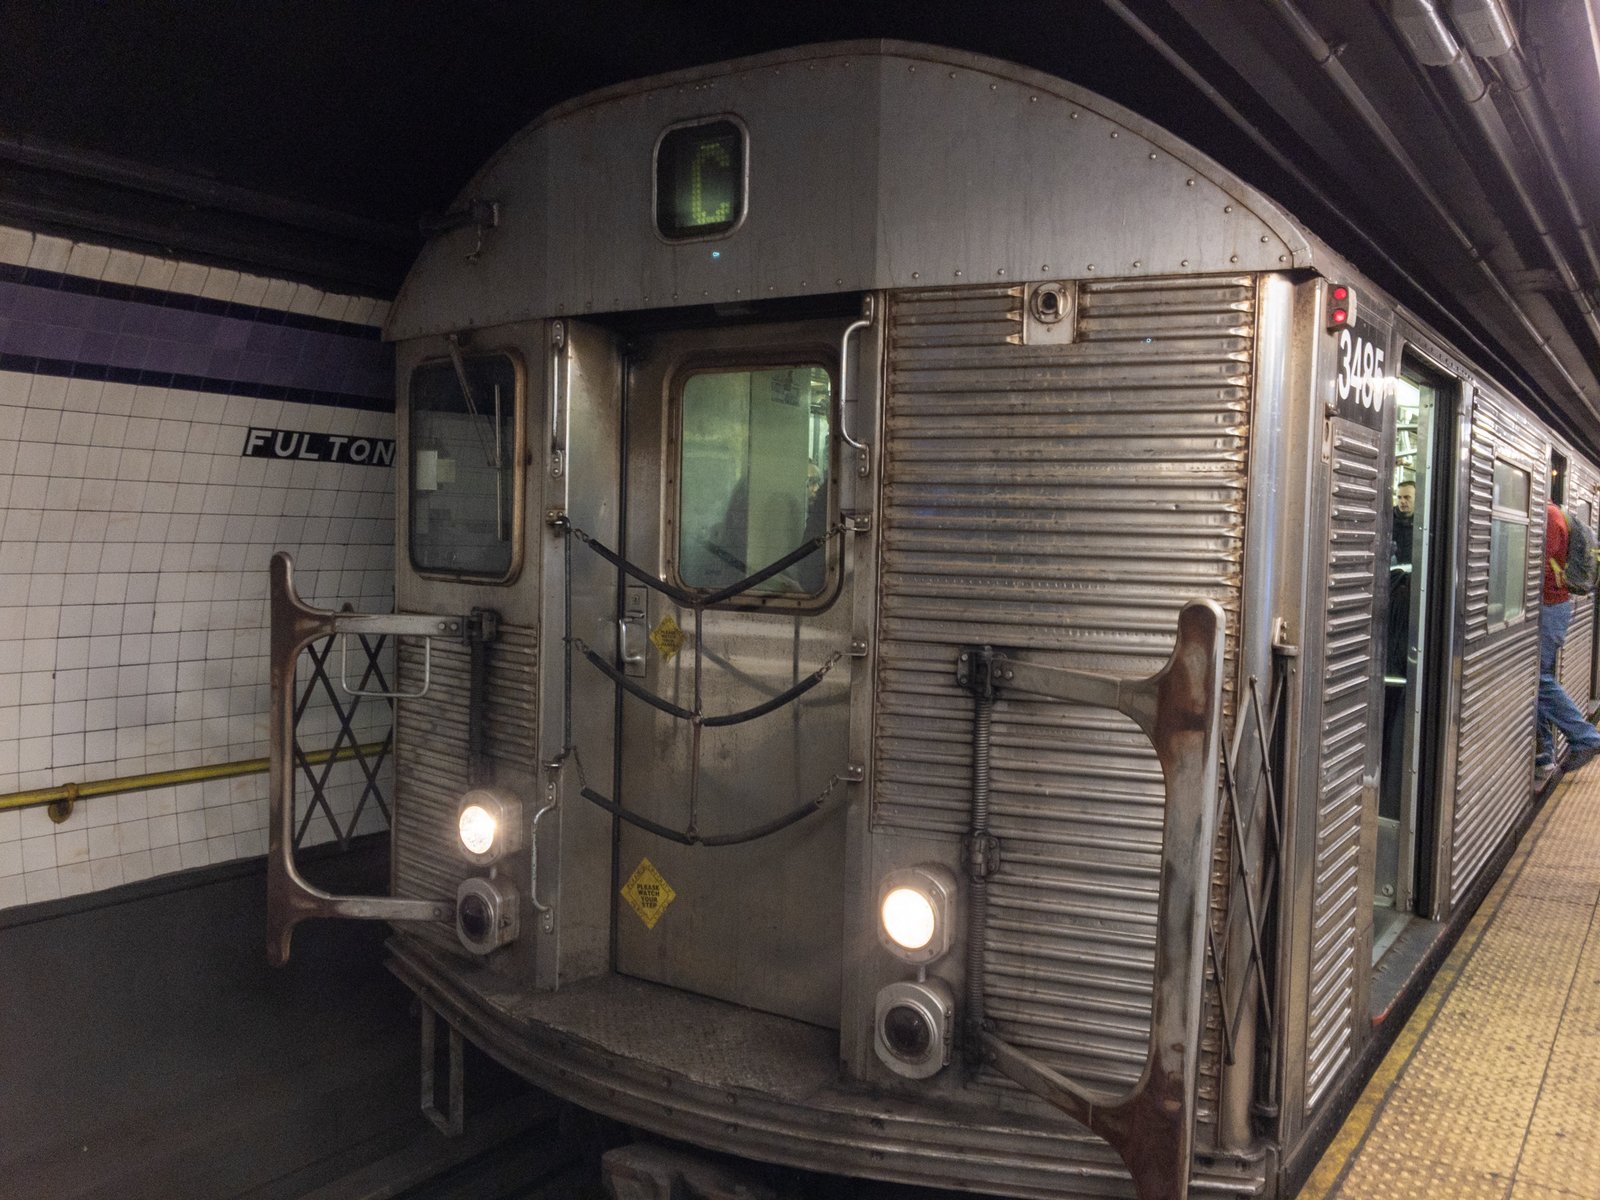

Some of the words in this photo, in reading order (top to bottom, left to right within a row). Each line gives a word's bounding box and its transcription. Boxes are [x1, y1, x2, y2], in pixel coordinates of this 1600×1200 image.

[692, 143, 730, 225] C
[1339, 329, 1384, 412] 3485
[245, 429, 396, 465] FULTON
